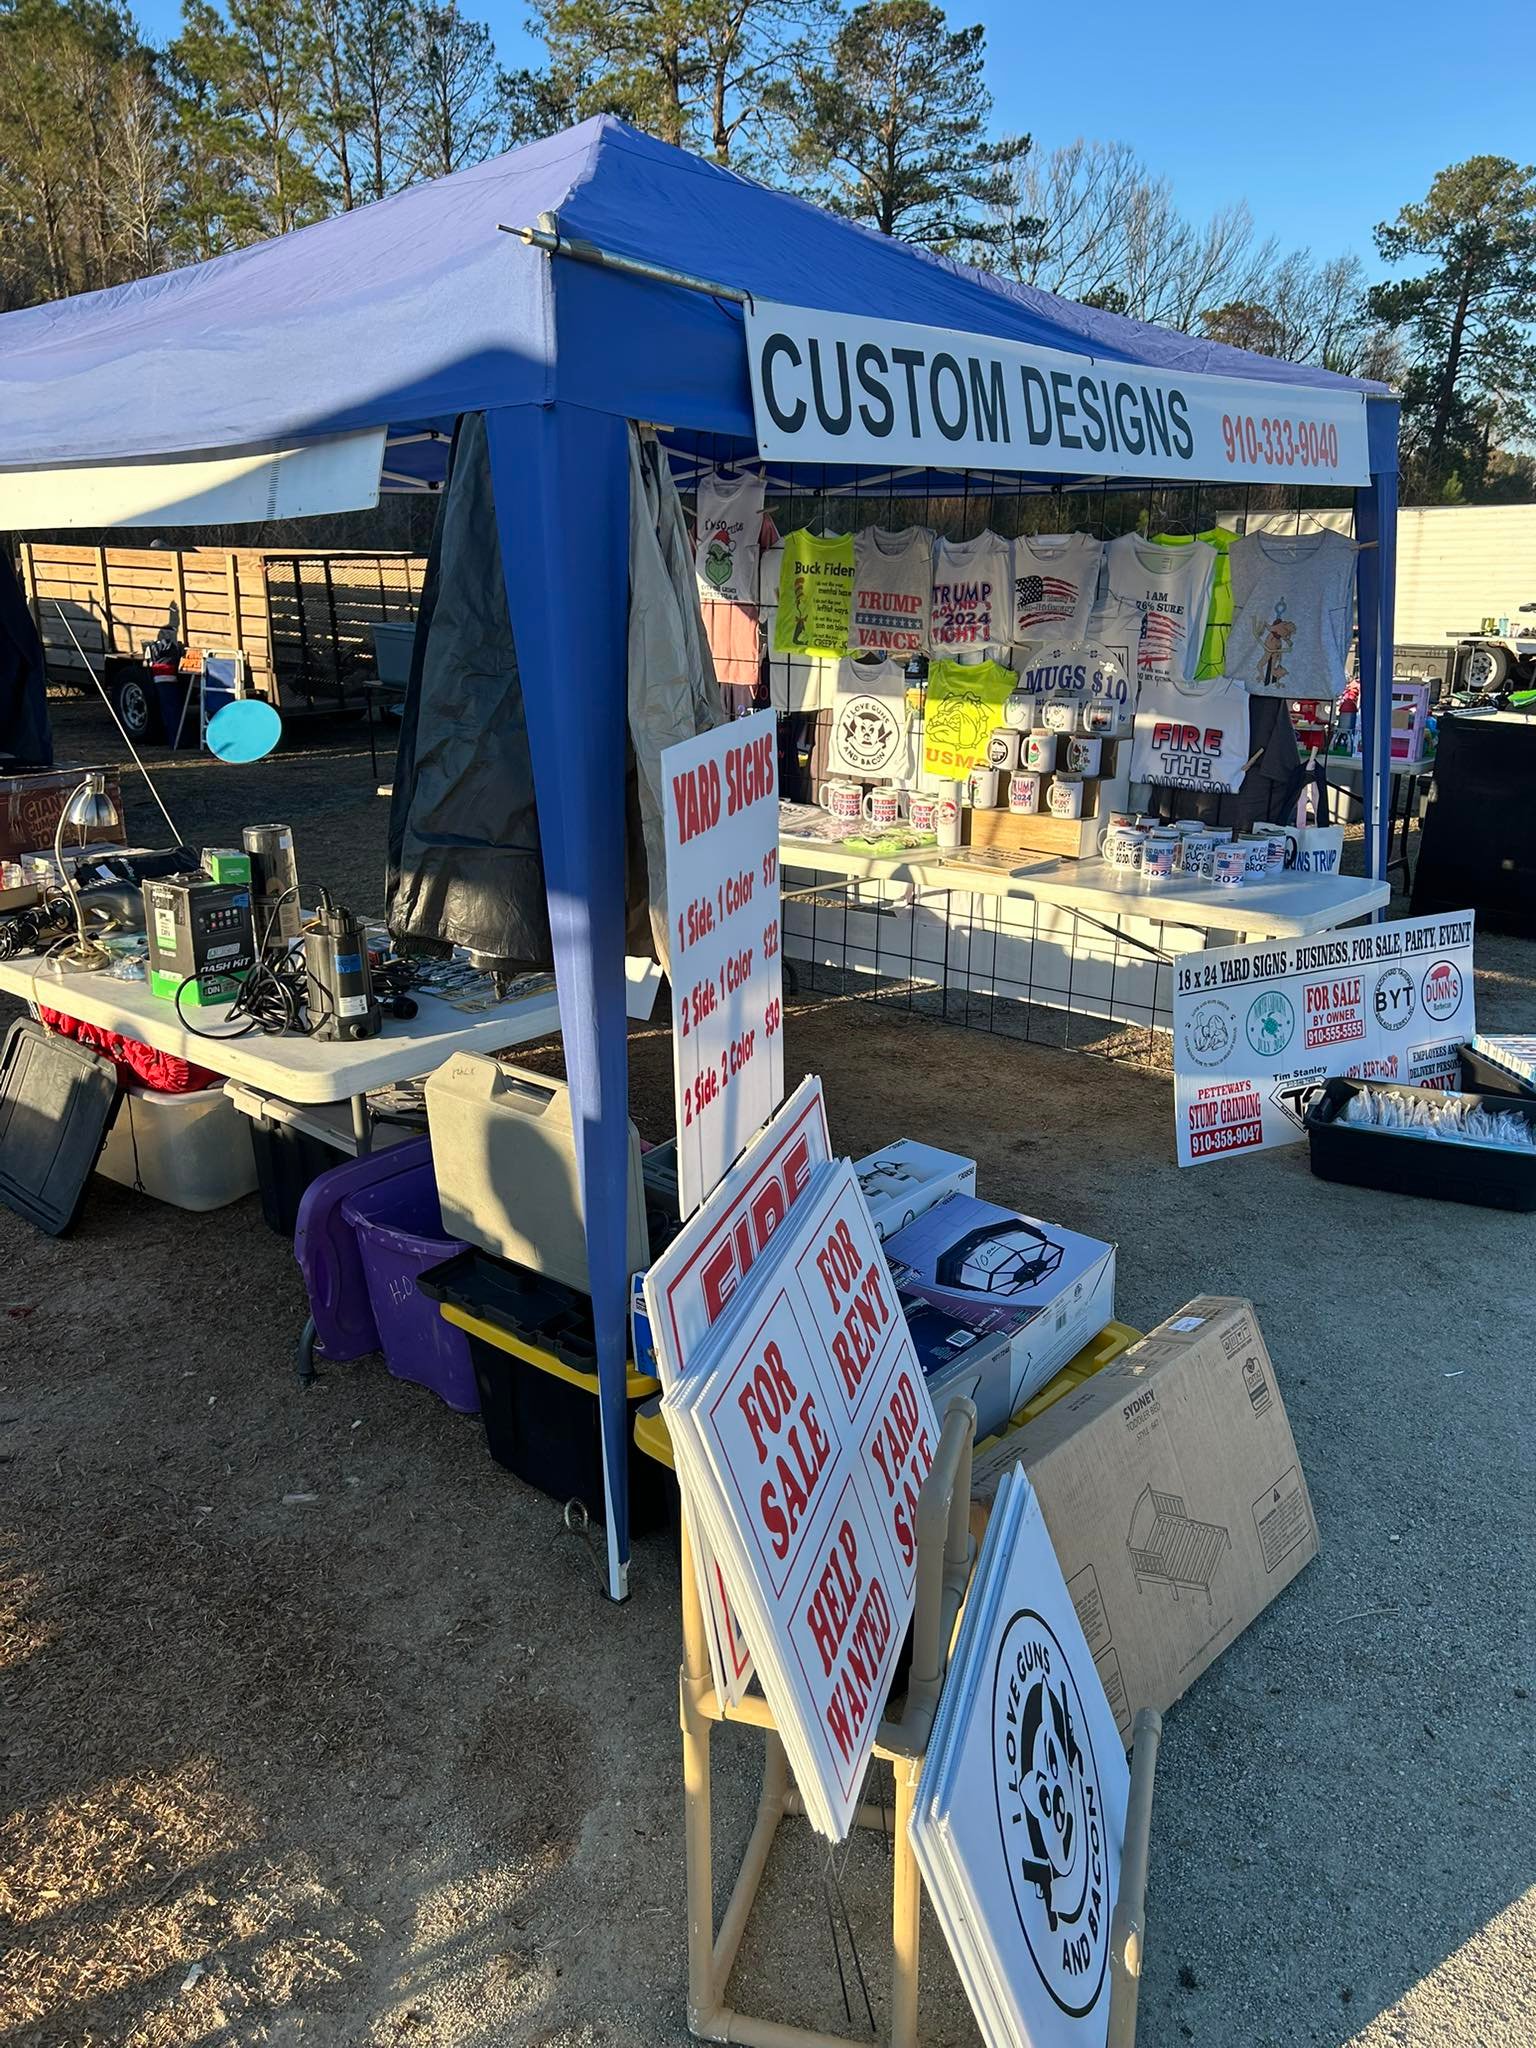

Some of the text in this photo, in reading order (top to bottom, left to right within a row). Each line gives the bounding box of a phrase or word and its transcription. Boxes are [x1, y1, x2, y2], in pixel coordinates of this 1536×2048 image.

[761, 333, 1194, 460] CUSTOM DESIGNS
[1222, 414, 1339, 468] 910-333-9040
[795, 561, 856, 577] Buck Fiden
[858, 591, 922, 614] TRUMP
[932, 581, 992, 603] TRUMP
[1151, 592, 1168, 602] AM
[1156, 602, 1185, 615] SURE
[944, 612, 991, 627] 2024
[858, 628, 921, 650] VANCE
[1026, 665, 1086, 694] MUGS
[1091, 669, 1128, 704] $10
[850, 703, 870, 715] LOVE
[871, 704, 890, 724] GUNS
[843, 746, 886, 766] AND BACON
[1152, 722, 1223, 757] FIRE
[1161, 752, 1212, 779] THE
[673, 732, 774, 845] YARD SIGNS
[678, 847, 777, 952] 1 Side, 1 Color $17
[232, 957, 251, 968] KIT
[1178, 968, 1191, 991] 18
[1194, 972, 1201, 988] x
[1204, 965, 1217, 987] 24
[1220, 957, 1250, 983] YARD
[1253, 951, 1287, 979] SIGNS
[1296, 941, 1351, 971] BUSINESS,
[1352, 938, 1373, 961] FOR
[1375, 932, 1402, 957] SALE,
[1405, 927, 1437, 952] PARTY,
[1439, 921, 1472, 946] EVENT
[682, 919, 778, 1037] 2 Side, 1 Color $22
[1426, 979, 1459, 1003] DUNN'S
[1306, 984, 1331, 1014] FOR
[1332, 979, 1361, 1007] SALE
[1375, 986, 1414, 1012] BYT
[1307, 1022, 1363, 1045] 910-555-5555
[1313, 1009, 1356, 1027] BY OWNER
[684, 997, 780, 1128] 2 Side, 2 Color $30
[1363, 1060, 1399, 1079] BIRTHDAY
[1413, 1046, 1447, 1062] EMPLOYEES
[1272, 1065, 1328, 1082] Tim Stanley
[1188, 1102, 1219, 1131] STUMP
[1220, 1093, 1262, 1125] GRINDING
[1192, 1123, 1261, 1154] 910-358-9047
[816, 1218, 863, 1315] FOR
[832, 1263, 890, 1400] RENT
[737, 1340, 798, 1465] FOR
[1123, 1389, 1155, 1420] SYDNEY
[871, 1371, 920, 1498] YARD
[760, 1391, 831, 1561] SALE
[806, 1518, 863, 1678] HELP
[826, 1576, 891, 1765] WANTED
[1003, 1641, 1051, 1825] I LOVE GUNS
[1062, 1785, 1103, 1977] AND BACON
